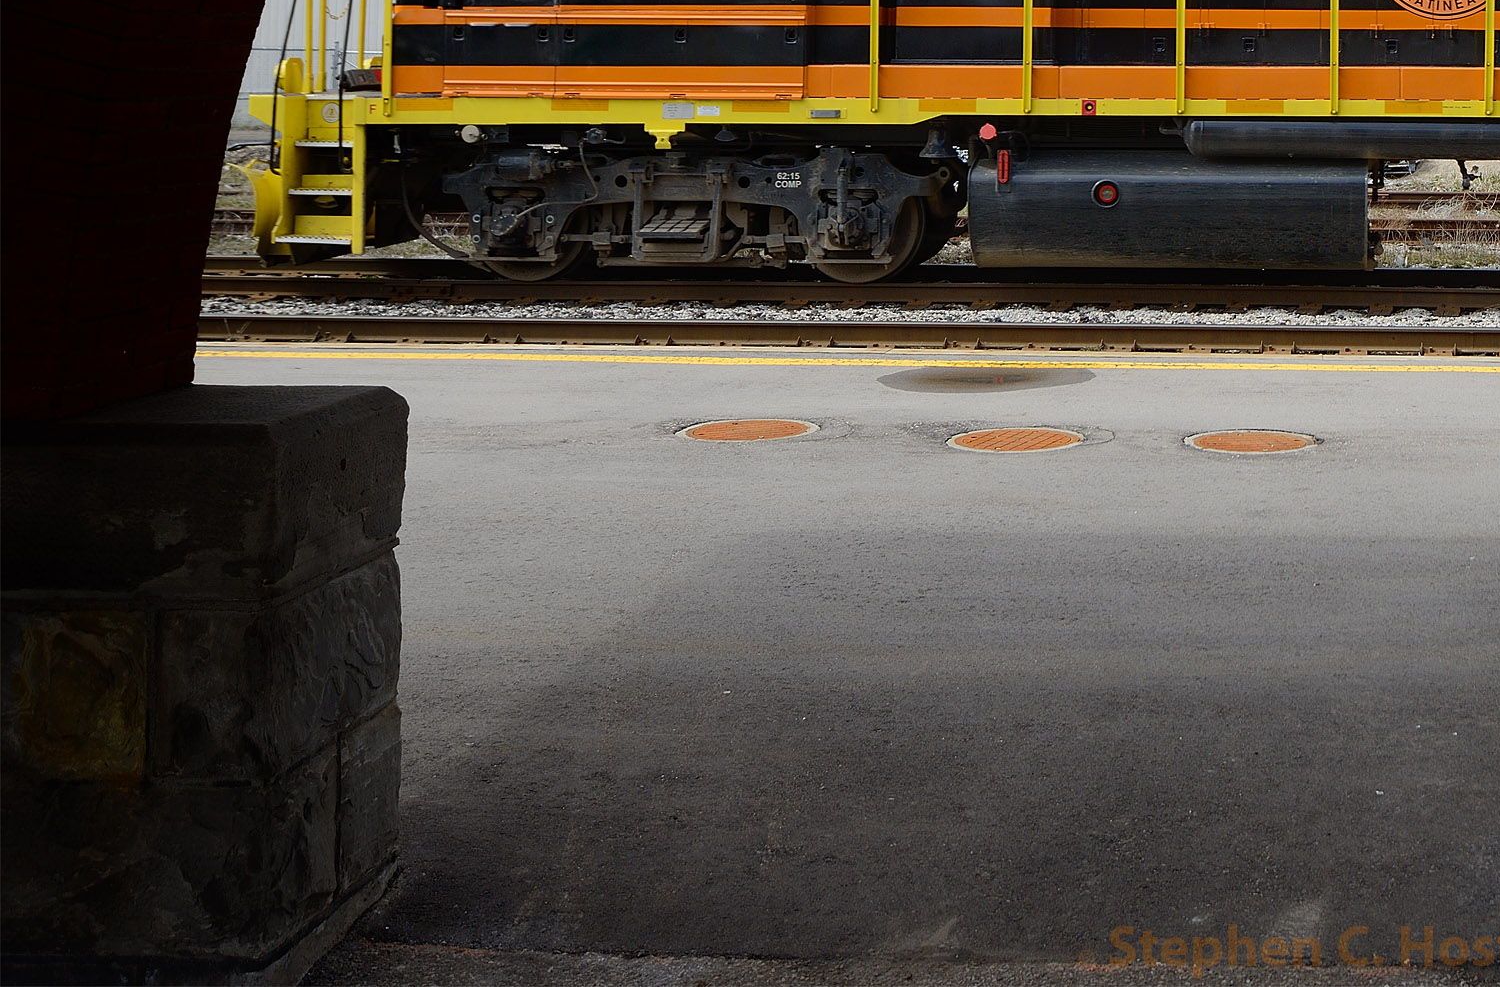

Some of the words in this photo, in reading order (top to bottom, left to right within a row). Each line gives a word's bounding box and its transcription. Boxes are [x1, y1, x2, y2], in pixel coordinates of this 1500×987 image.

[369, 104, 377, 114] F
[776, 172, 801, 180] 62:15
[774, 180, 802, 188] COMP
